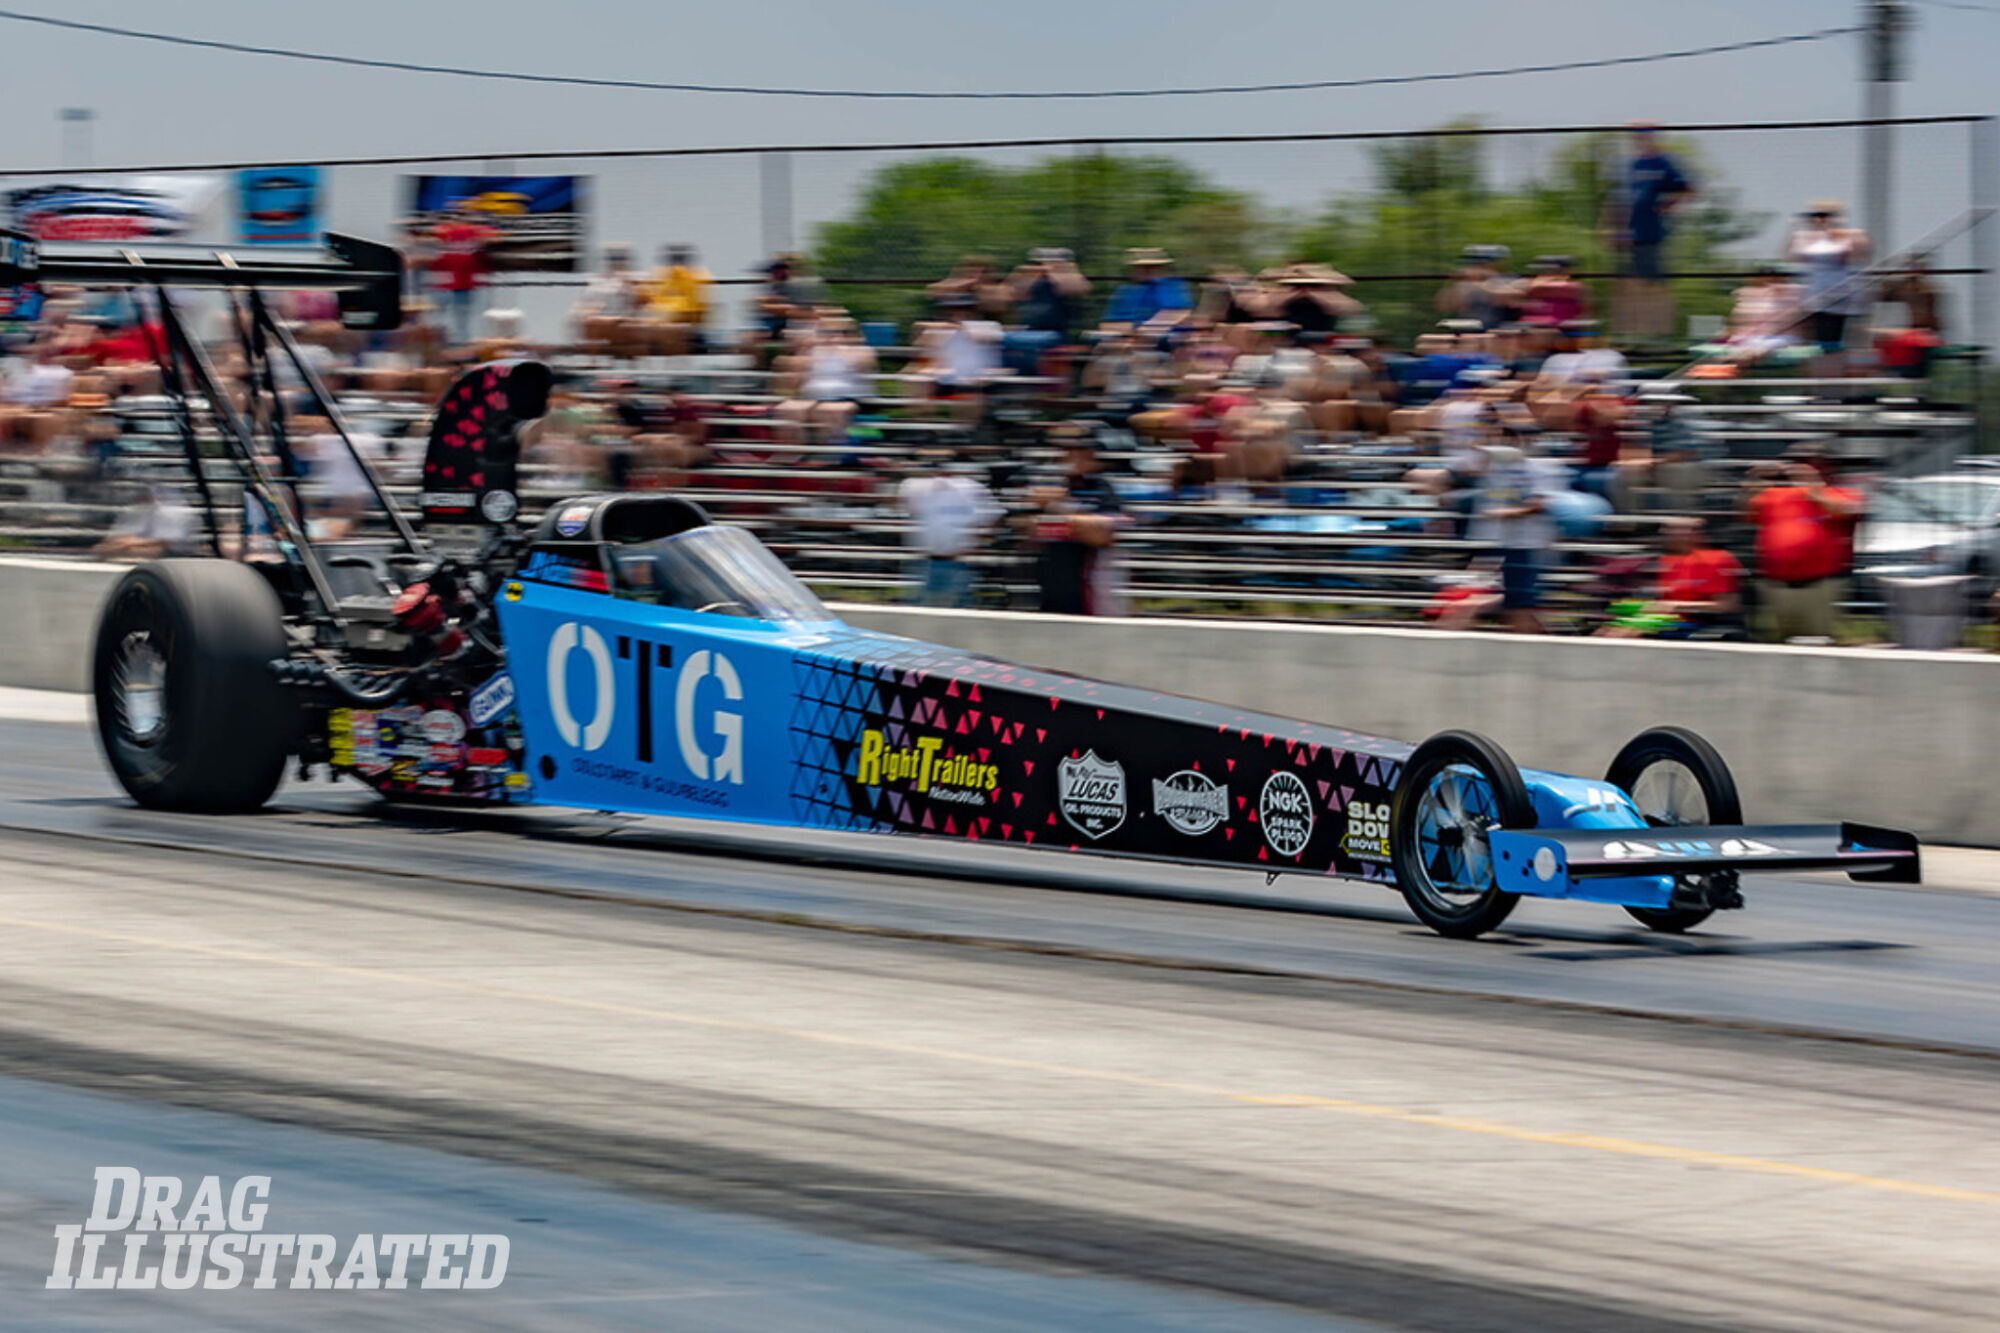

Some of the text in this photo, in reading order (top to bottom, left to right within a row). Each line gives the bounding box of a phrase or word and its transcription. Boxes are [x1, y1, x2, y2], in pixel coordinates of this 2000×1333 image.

[546, 621, 744, 786] OTG
[1068, 780, 1119, 802] LUCAS
[1268, 791, 1302, 813] NGK
[1080, 804, 1122, 818] PRODUCTS
[1271, 816, 1302, 828] SPARK
[1271, 828, 1303, 843] PLUGS
[1348, 838, 1381, 852] MOVE
